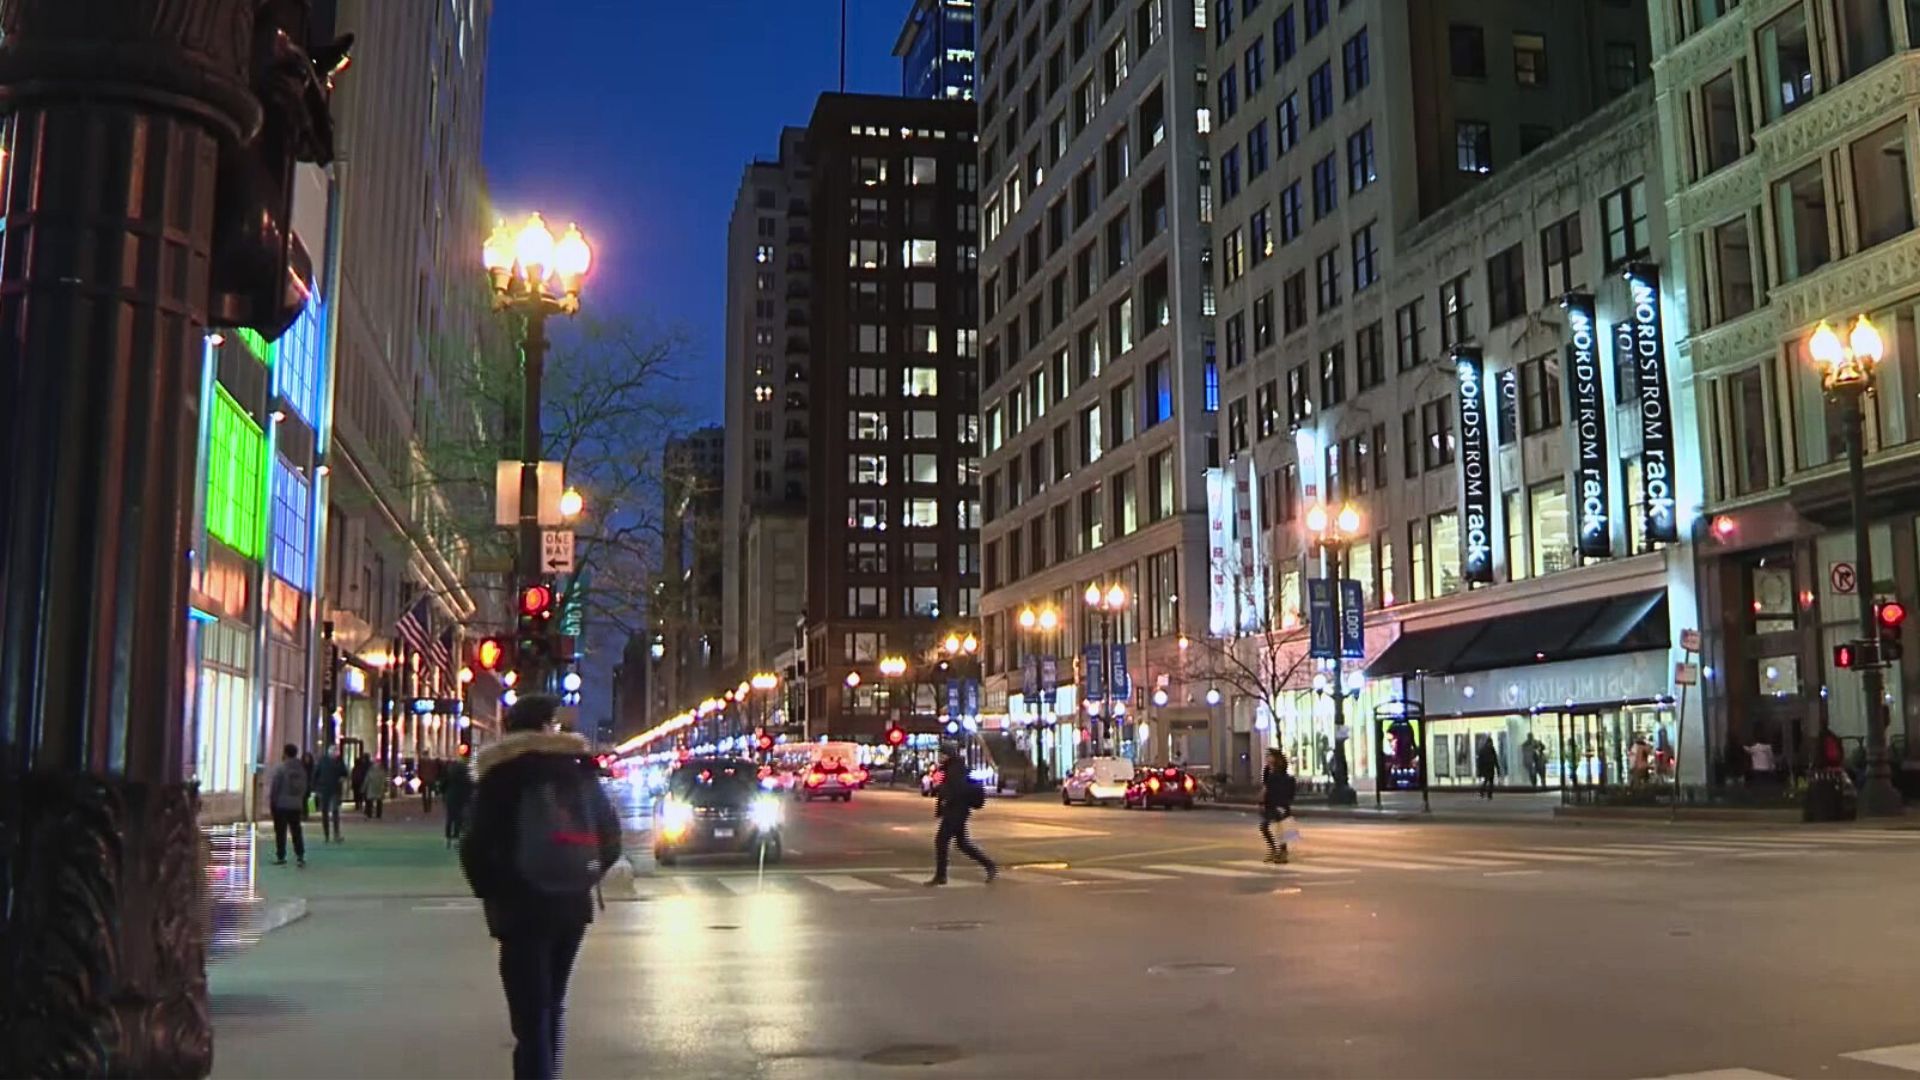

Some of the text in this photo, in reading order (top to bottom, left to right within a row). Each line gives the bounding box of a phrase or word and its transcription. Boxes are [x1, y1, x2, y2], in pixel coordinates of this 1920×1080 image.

[1572, 311, 1608, 537] NORDSTROM rack
[1633, 281, 1675, 519] NORDSTROM rack
[1459, 361, 1490, 564] NORDSTROM rack
[546, 534, 571, 544] ONE
[546, 546, 569, 556] WAY
[1346, 609, 1359, 639] LOOP
